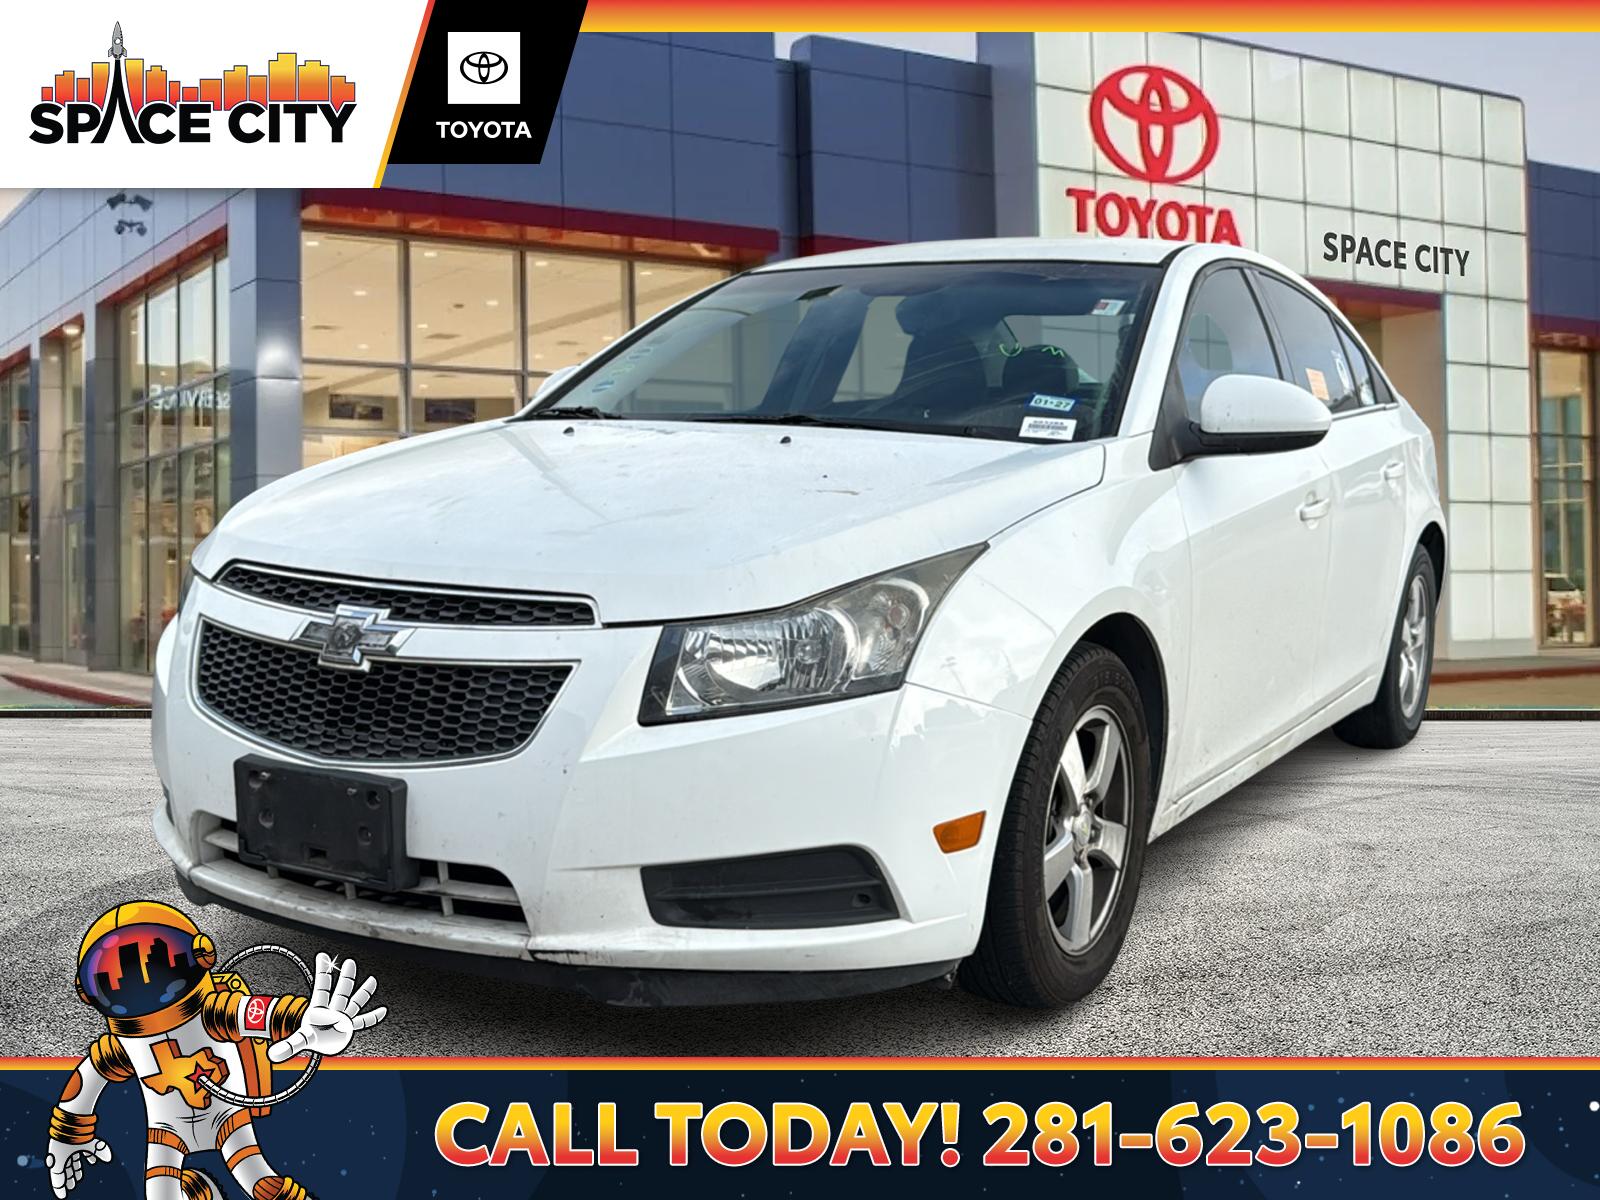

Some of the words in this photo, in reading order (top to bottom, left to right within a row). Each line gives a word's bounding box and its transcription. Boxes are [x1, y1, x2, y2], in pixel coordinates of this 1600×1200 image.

[1066, 188, 1242, 247] TOYOTA
[1323, 232, 1407, 270] SPACE
[1414, 244, 1470, 277] CITY
